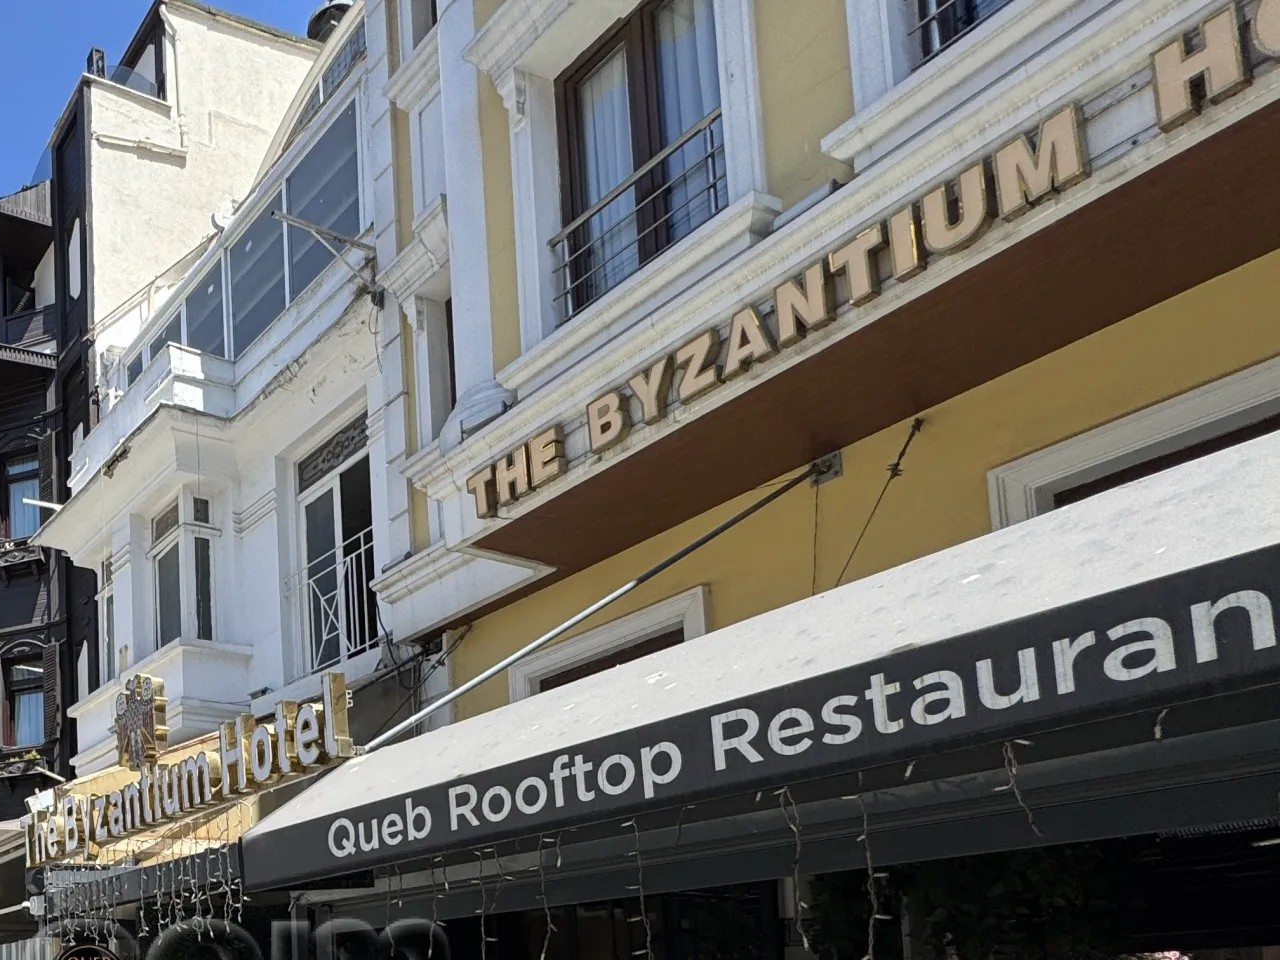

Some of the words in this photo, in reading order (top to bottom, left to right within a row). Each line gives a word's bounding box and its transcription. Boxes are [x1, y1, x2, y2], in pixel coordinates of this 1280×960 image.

[467, 425, 566, 519] THE
[586, 103, 1092, 453] BYZANTIUM
[20, 812, 58, 868] The
[63, 749, 212, 862] Byzantium
[219, 671, 348, 796] Hotel
[326, 798, 435, 860] Queb
[447, 737, 683, 834] Rooftop
